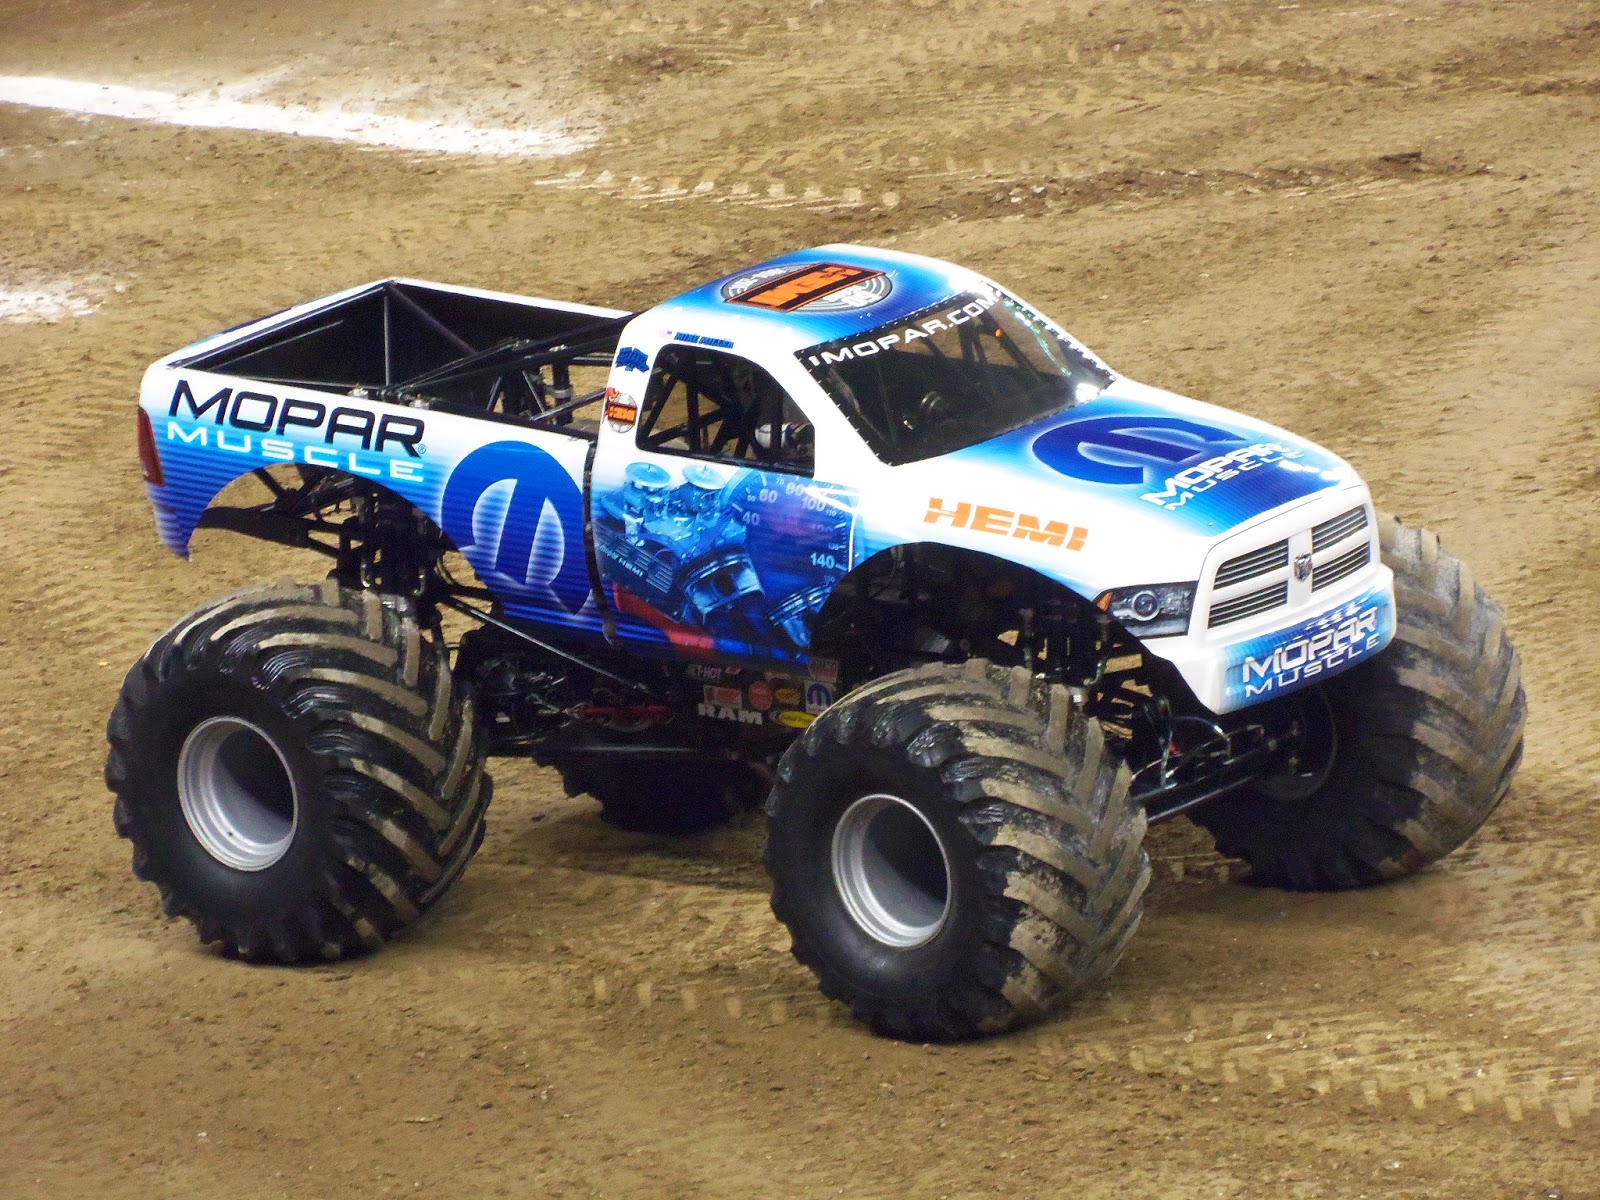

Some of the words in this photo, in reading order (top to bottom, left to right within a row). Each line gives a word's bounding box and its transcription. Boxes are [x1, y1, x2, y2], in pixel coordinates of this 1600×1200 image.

[168, 380, 425, 458] MOPAR
[167, 421, 424, 482] MUSCLE
[1139, 443, 1285, 506] MOPAR
[760, 488, 778, 504] 60
[802, 496, 826, 512] 100
[1164, 448, 1304, 511] MUSCLE
[742, 511, 760, 526] 40
[923, 497, 1089, 552] HEMI
[618, 557, 644, 577] HEMI
[810, 552, 836, 569] 140
[1242, 606, 1379, 683] MOPAR
[1245, 633, 1380, 698] MUSCLE
[698, 702, 763, 725] RAM
